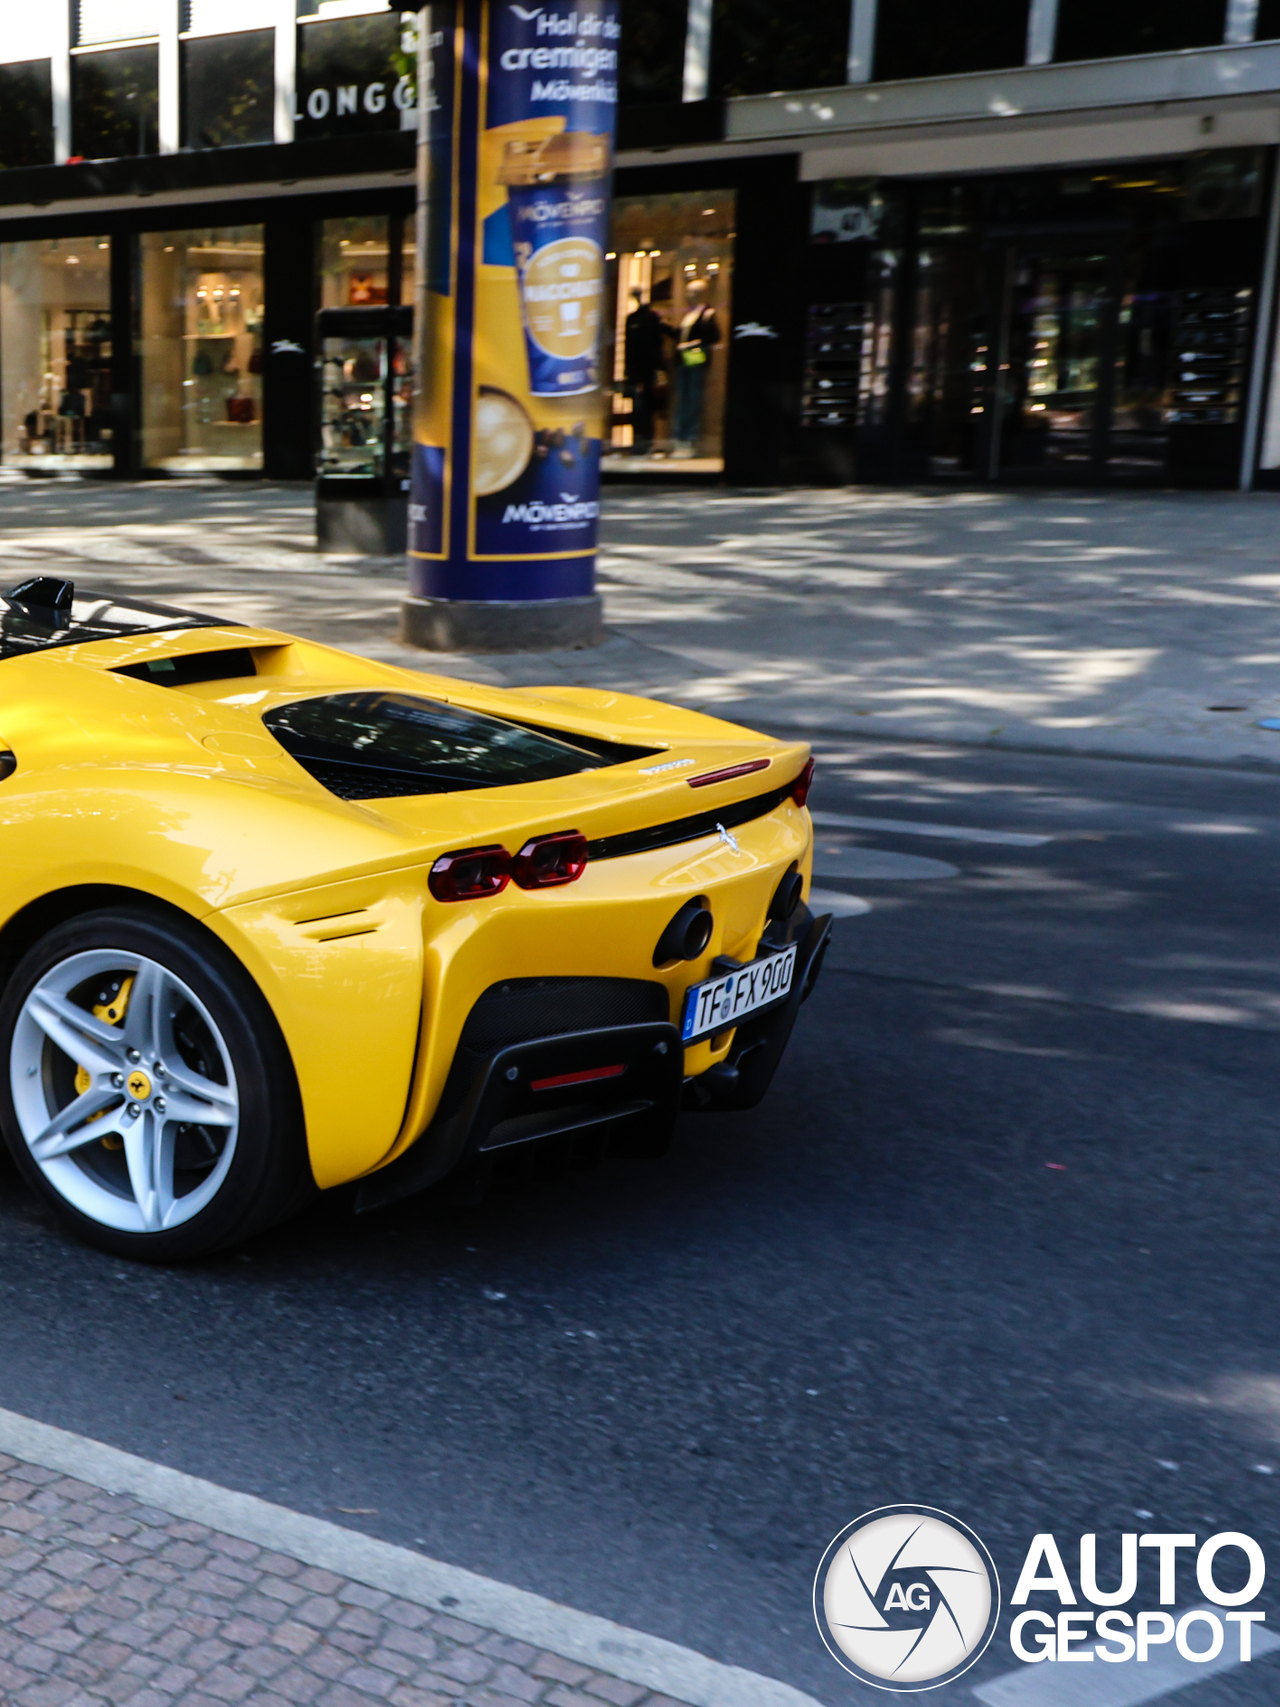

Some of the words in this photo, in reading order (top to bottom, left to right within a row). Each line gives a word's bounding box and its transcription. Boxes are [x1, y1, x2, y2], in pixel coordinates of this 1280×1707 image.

[536, 12, 577, 36] Hol
[578, 12, 603, 37] dir
[500, 39, 618, 78] cremigen
[700, 983, 725, 1028] TF
[733, 967, 760, 1013] FX
[761, 953, 793, 1000] 900
